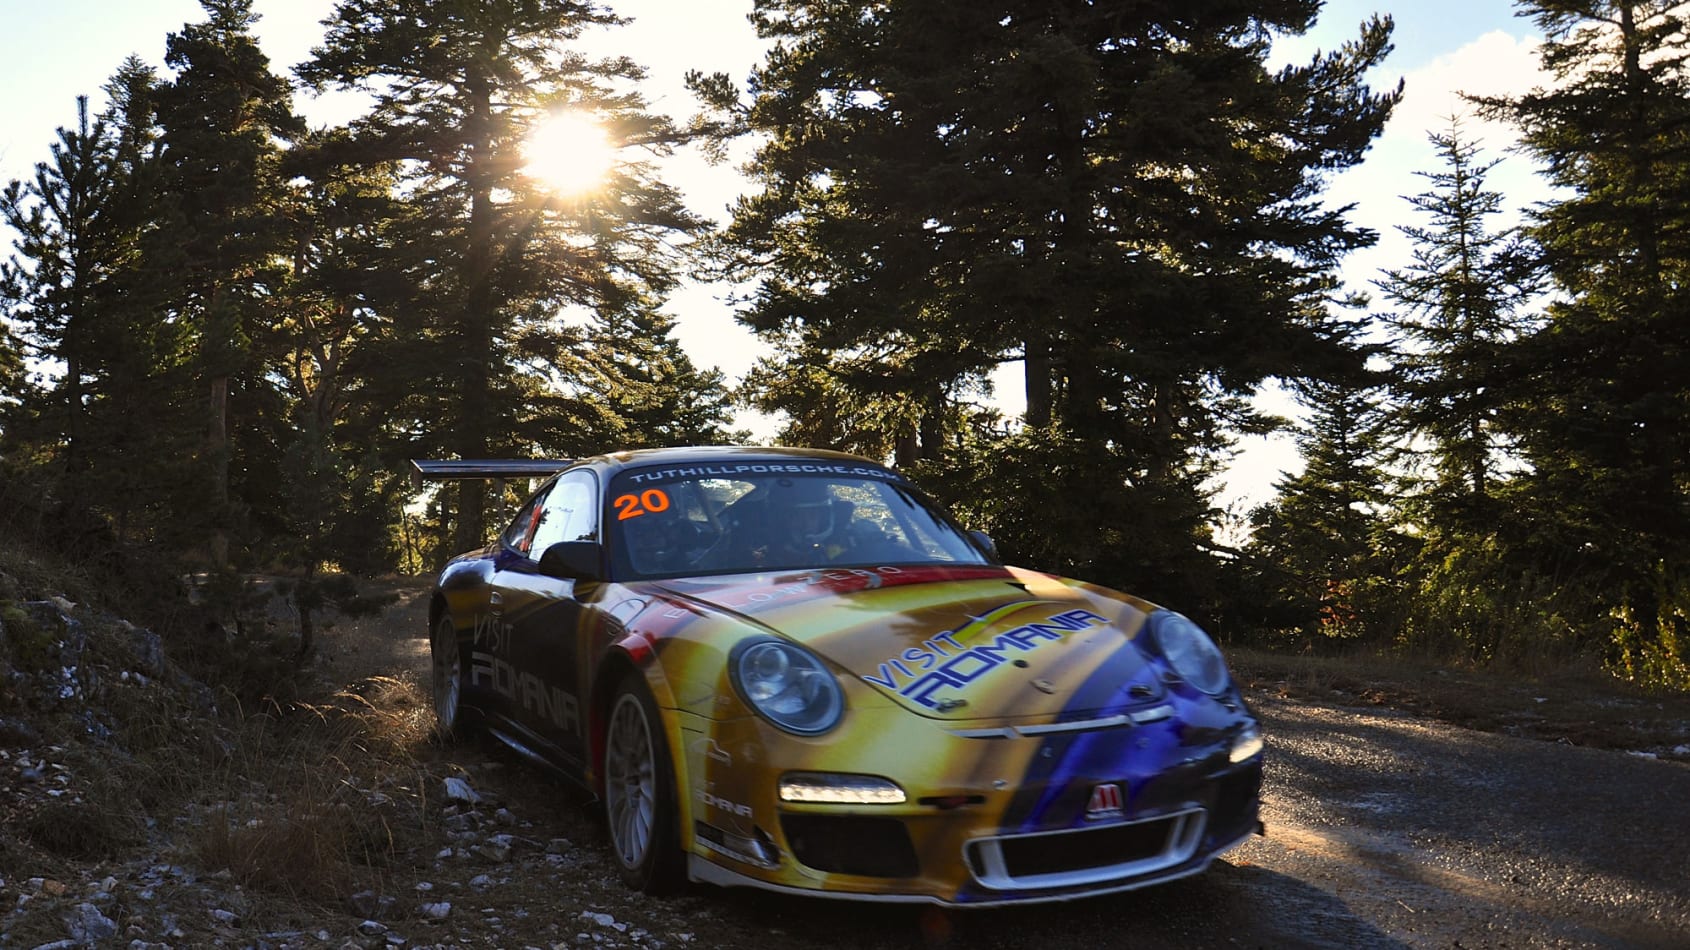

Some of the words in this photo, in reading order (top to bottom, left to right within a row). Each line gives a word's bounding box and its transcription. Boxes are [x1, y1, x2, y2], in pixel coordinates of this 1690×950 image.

[629, 464, 899, 482] TUTHILLPORSCHE.COM
[613, 489, 670, 521] 20
[472, 613, 514, 658] VISIT
[861, 631, 965, 691] VISIT
[898, 608, 1112, 709] ROMANIA
[470, 650, 582, 737] ROMANIA
